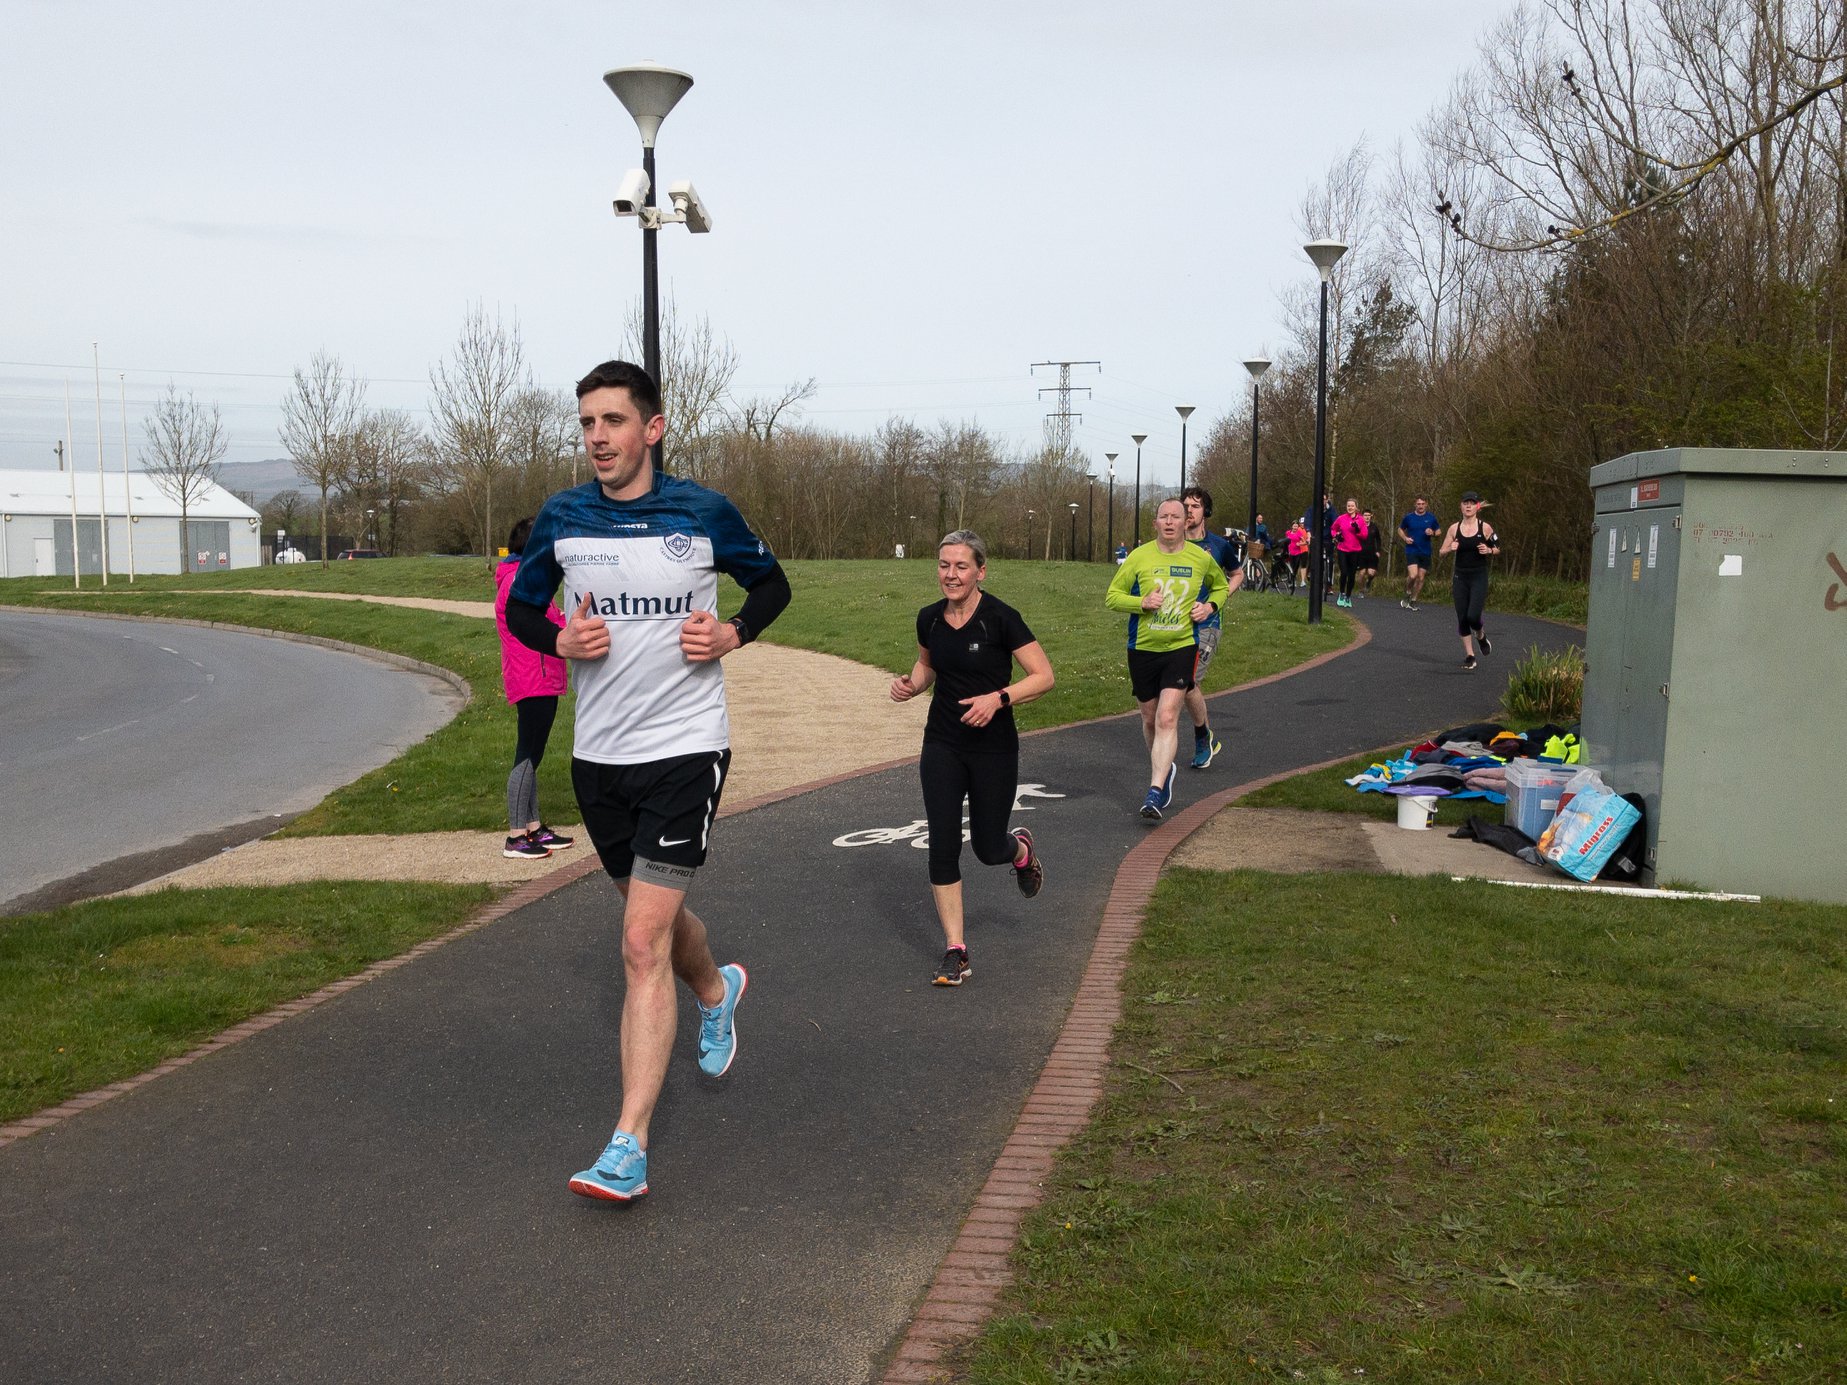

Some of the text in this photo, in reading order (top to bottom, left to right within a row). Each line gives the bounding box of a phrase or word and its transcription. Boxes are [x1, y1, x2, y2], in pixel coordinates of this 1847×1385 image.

[564, 553, 619, 562] naturactive
[574, 590, 693, 615] Matmut
[1578, 816, 1614, 855] Migross
[645, 862, 668, 873] NIKE
